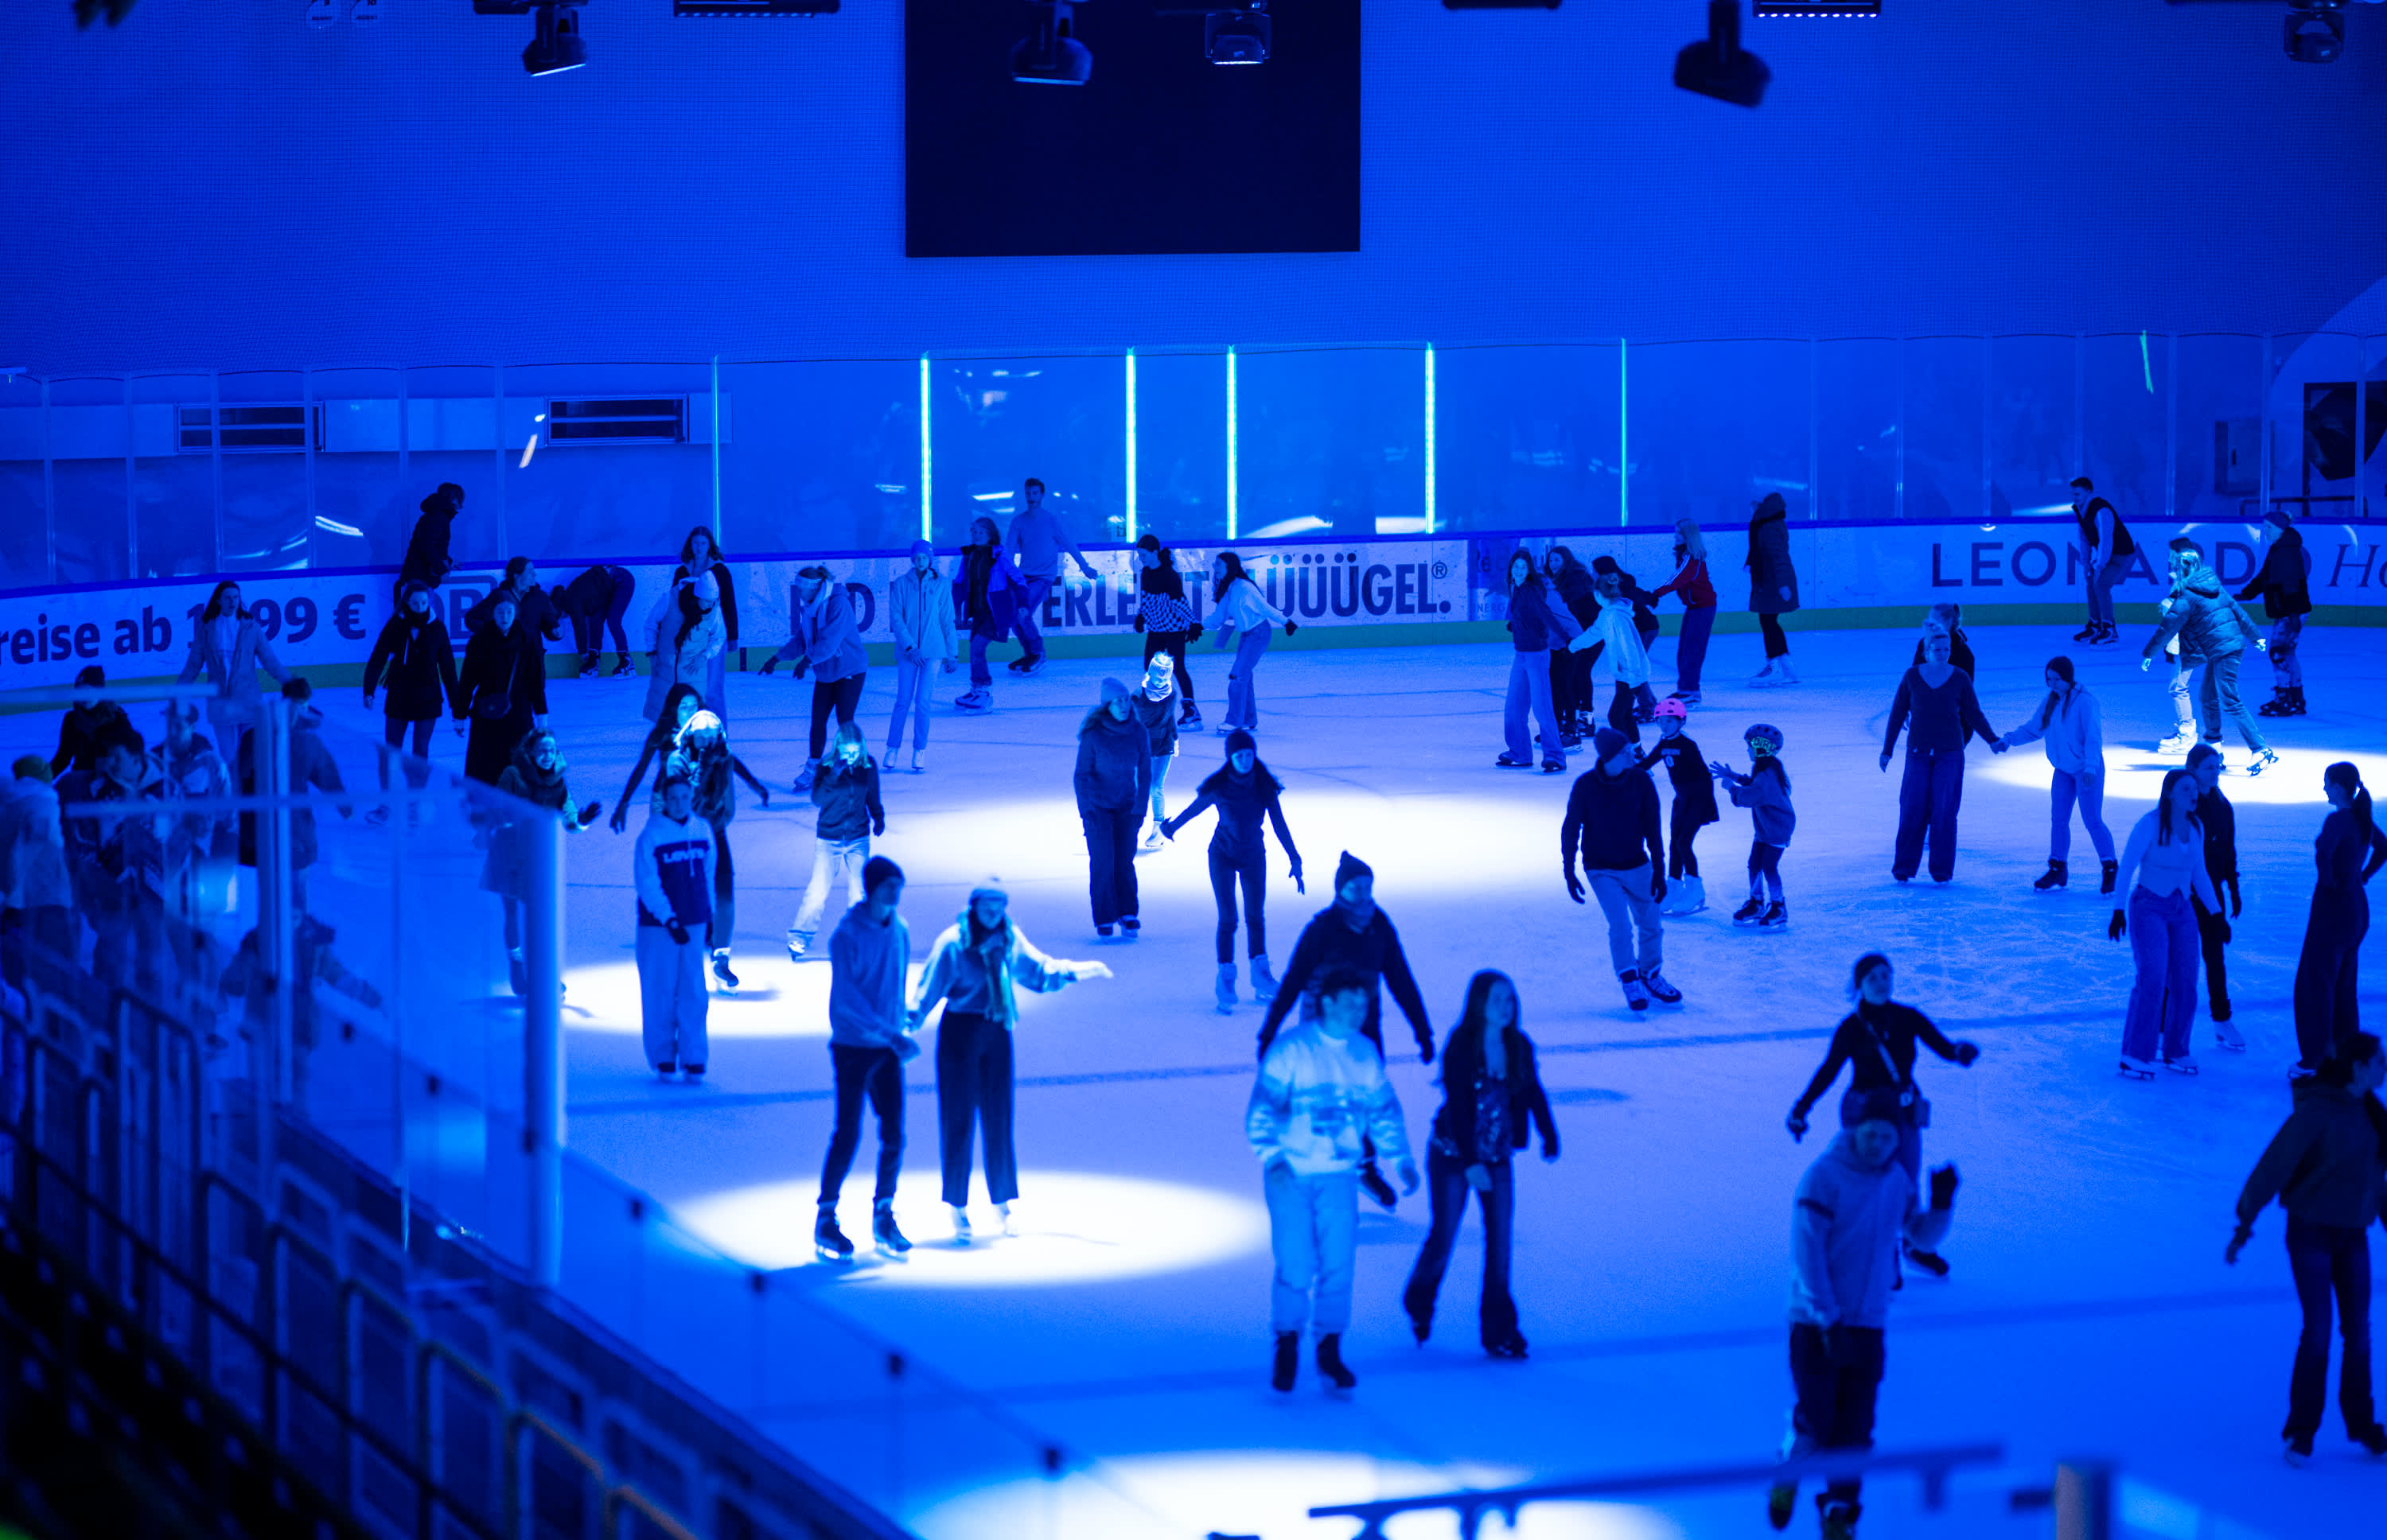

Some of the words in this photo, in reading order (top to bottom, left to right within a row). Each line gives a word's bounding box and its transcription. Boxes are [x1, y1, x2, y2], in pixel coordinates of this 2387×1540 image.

[1932, 541, 2311, 587] LEOAD
[114, 605, 172, 655] ab
[333, 593, 366, 640] €
